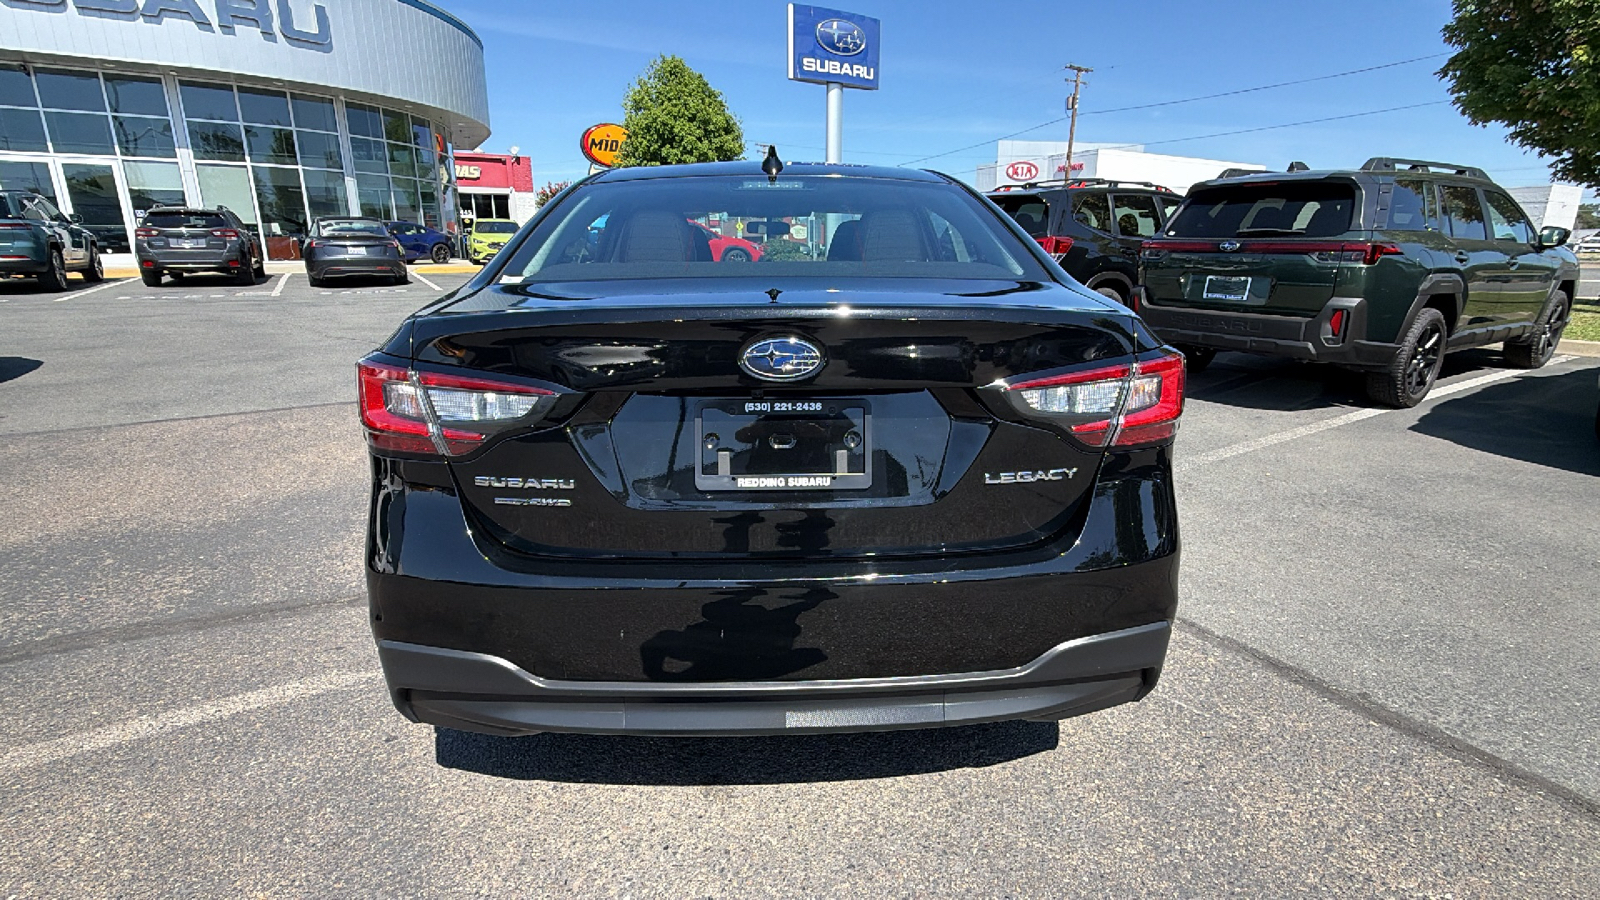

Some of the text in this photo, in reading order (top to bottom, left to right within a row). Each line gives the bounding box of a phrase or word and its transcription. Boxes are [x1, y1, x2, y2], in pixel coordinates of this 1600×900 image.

[0, 0, 333, 46] ARU
[802, 57, 874, 80] SUBARU
[590, 138, 619, 152] MID
[1010, 163, 1034, 179] KIA
[1171, 314, 1262, 333] SUBARU
[744, 402, 822, 412] (530) 221-2436
[474, 476, 575, 489] SUBARU
[737, 477, 831, 488] REDDING SUBARU
[985, 467, 1078, 484] LEGACY
